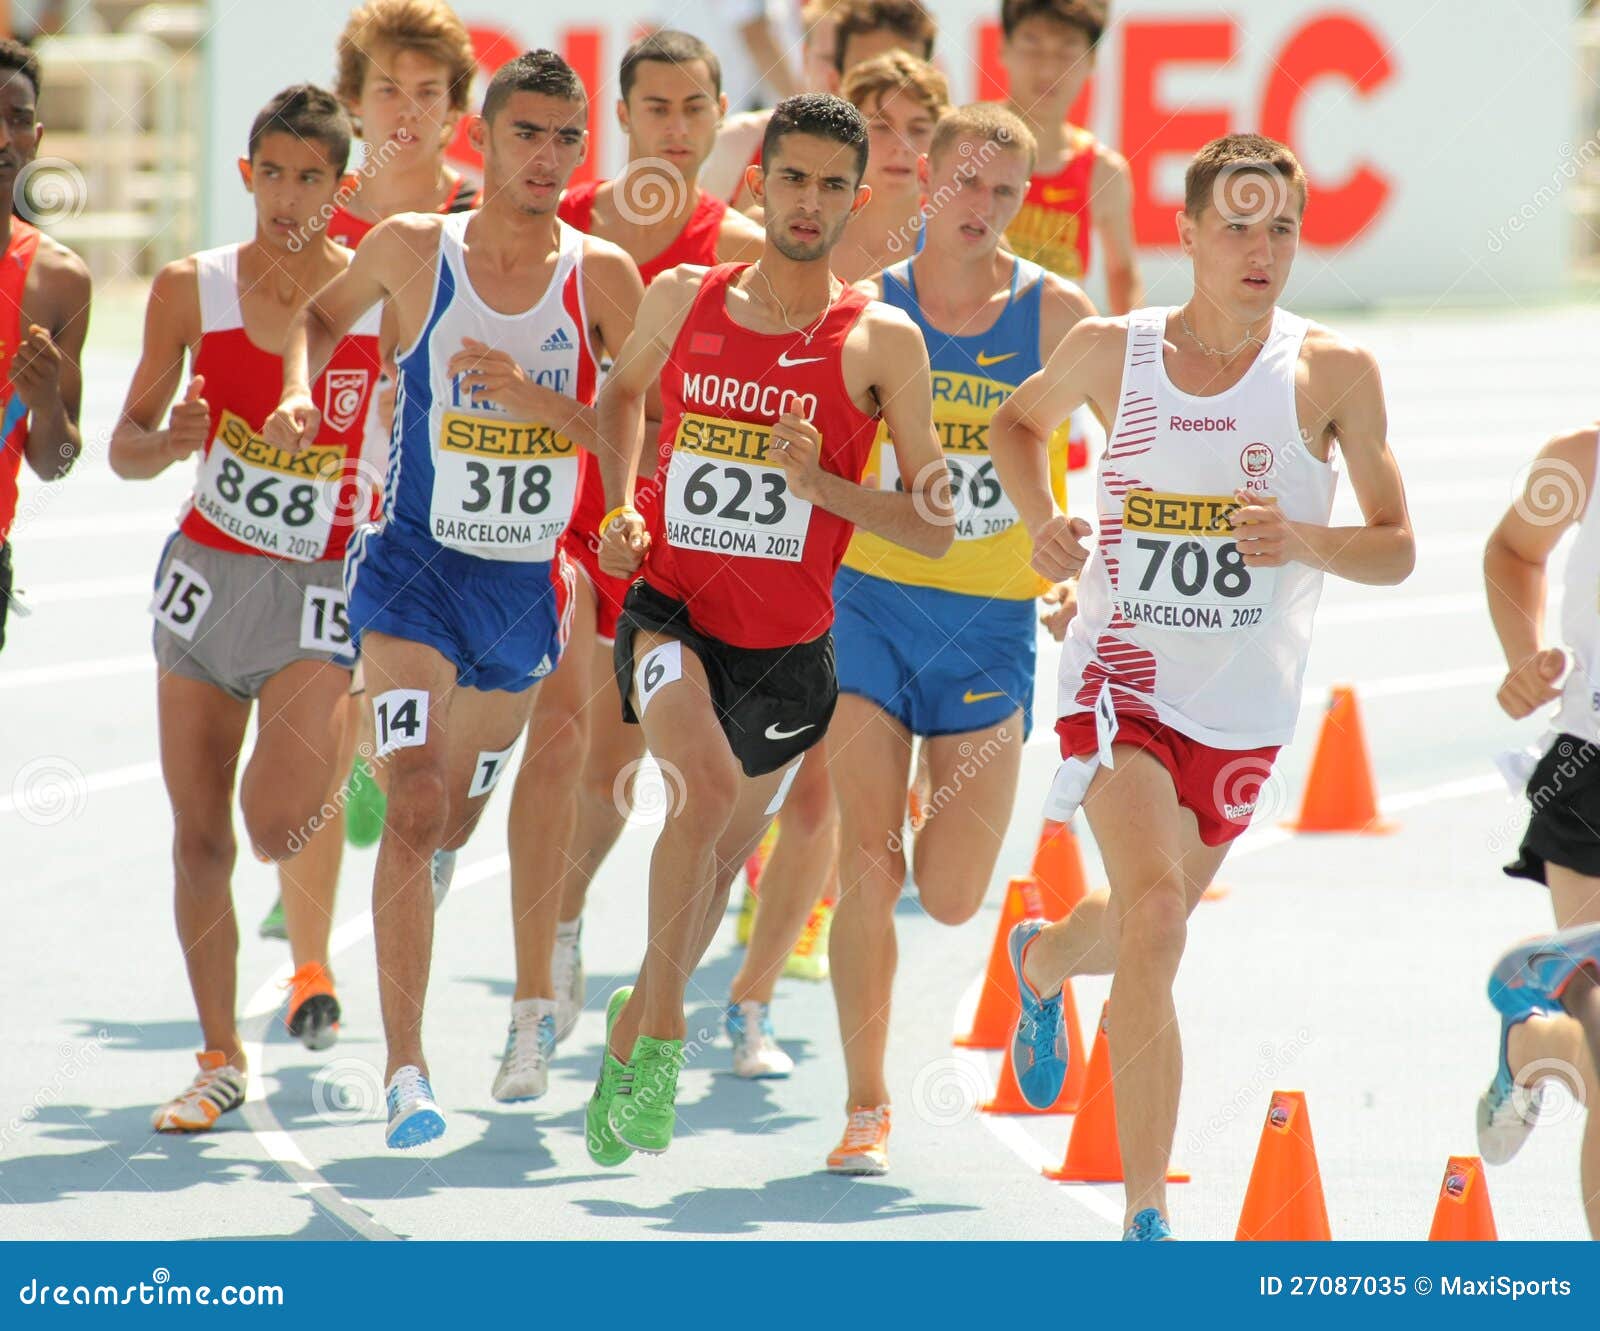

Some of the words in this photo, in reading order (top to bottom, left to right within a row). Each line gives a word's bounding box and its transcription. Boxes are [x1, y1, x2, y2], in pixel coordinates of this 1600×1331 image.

[540, 341, 574, 352] adidas
[680, 419, 771, 461] SEIK
[1169, 415, 1237, 432] Reebok
[221, 418, 342, 478] SEIKO
[216, 457, 319, 528] 868
[461, 460, 553, 516] 318
[683, 462, 788, 525] 623
[1246, 479, 1270, 491] POL
[199, 493, 279, 550] BARCELONA
[287, 535, 320, 559] 2012
[435, 518, 532, 544] BARCELONA
[537, 520, 566, 542] 2012
[1126, 495, 1243, 532] SEIK
[667, 521, 757, 553] BARCELONA
[765, 536, 800, 558] 2012
[1136, 537, 1252, 598] 708
[159, 571, 205, 625] 15
[1123, 600, 1223, 629] BARCELONA
[1230, 607, 1263, 628] 2012
[311, 598, 351, 644] 15
[644, 652, 665, 693] 6
[377, 698, 421, 745] 14
[480, 759, 504, 789] 1
